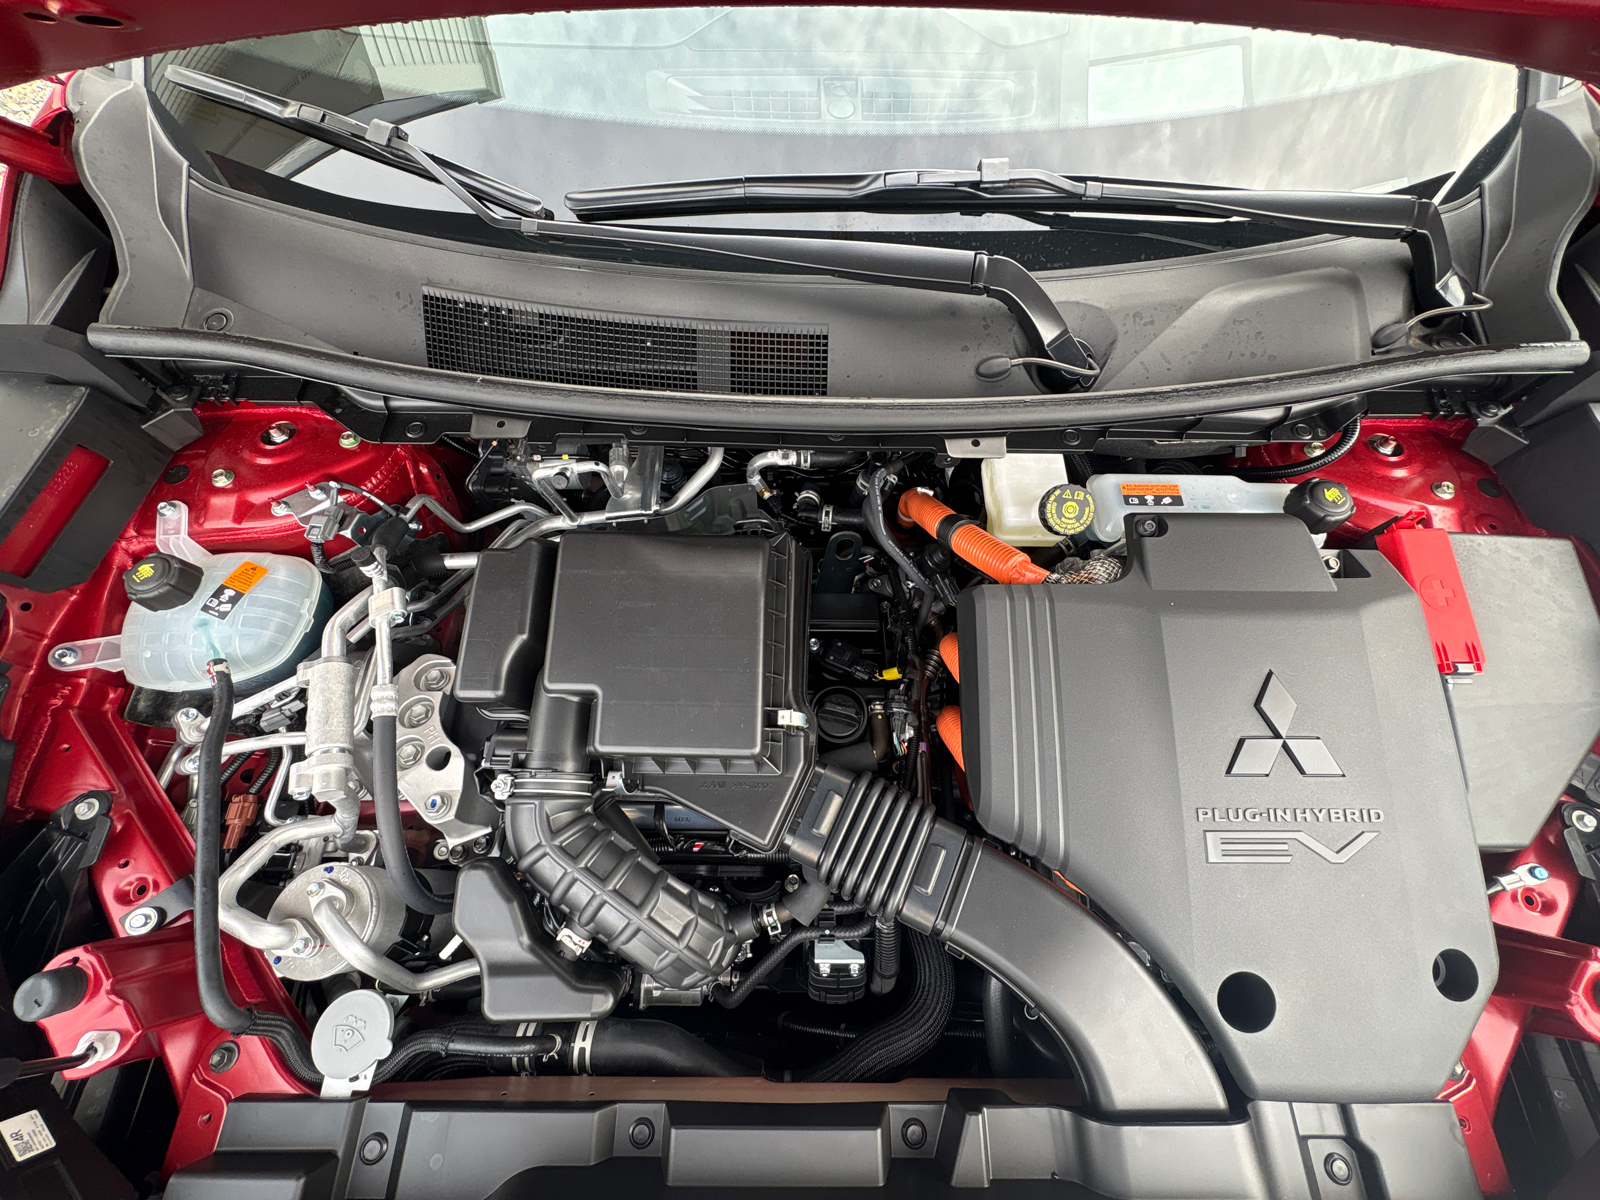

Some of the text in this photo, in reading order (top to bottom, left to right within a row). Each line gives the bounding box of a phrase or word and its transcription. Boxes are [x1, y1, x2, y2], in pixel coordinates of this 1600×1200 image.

[1196, 807, 1385, 823] PLUG-IN HYBRID
[1203, 829, 1381, 864] EV
[10, 1129, 24, 1142] 4R
